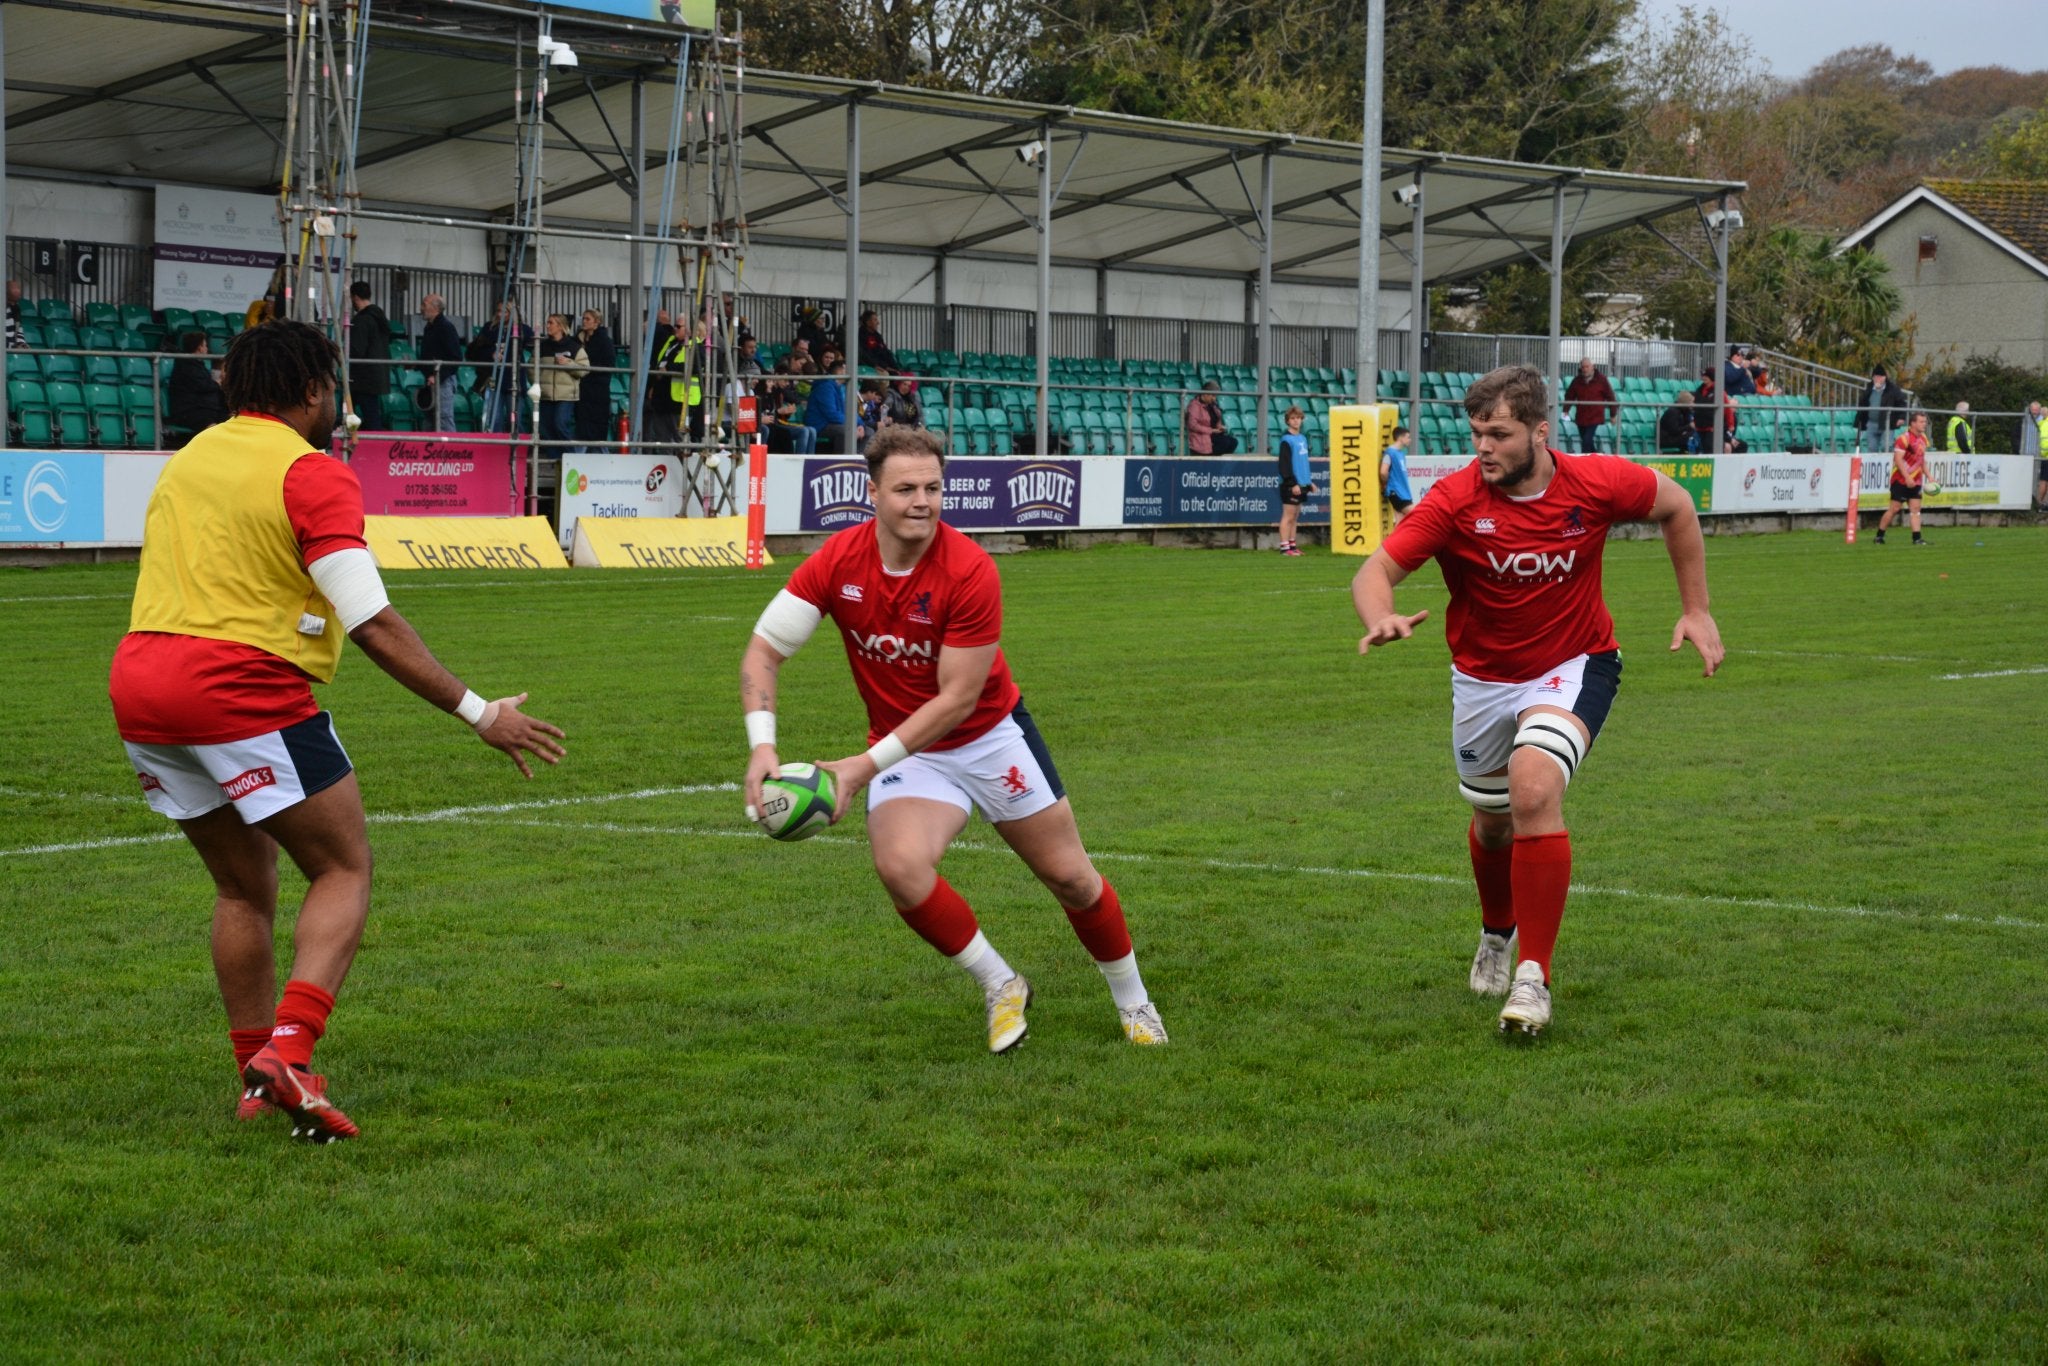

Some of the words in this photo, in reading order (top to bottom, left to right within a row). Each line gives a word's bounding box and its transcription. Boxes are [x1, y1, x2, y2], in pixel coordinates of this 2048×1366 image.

[77, 254, 92, 282] C
[389, 441, 418, 460] Chris
[422, 442, 474, 462] Sedgeman
[388, 462, 461, 476] SCAFFOLDING
[462, 463, 475, 472] LTD
[1691, 463, 1712, 478] SON
[1760, 465, 1806, 480] Microcomms
[1859, 462, 1882, 489] RURO
[1934, 461, 1971, 488] COLLEGE
[405, 484, 429, 495] 01736
[809, 470, 872, 510] TRIBUT
[949, 478, 975, 491] BEER
[977, 478, 991, 491] OF
[1007, 470, 1076, 509] TRIBUTE
[1182, 472, 1210, 487] Official
[1211, 475, 1243, 491] eyecare
[1244, 474, 1279, 491] partners
[1342, 420, 1365, 547] THATCHERS
[1772, 486, 1794, 501] Stand
[394, 497, 468, 509] www.sedgeman.co.uk
[592, 503, 638, 518] Tackling
[942, 496, 960, 510] EST
[962, 496, 995, 510] RUGBY
[1125, 505, 1162, 516] OPTICIANS
[1181, 498, 1190, 512] to
[1191, 496, 1205, 512] the
[1206, 497, 1238, 512] Cornish
[1239, 497, 1268, 512] Pirates
[820, 512, 847, 526] CORNISH
[848, 511, 861, 522] PALE
[1016, 510, 1040, 524] CORNISH
[1040, 510, 1053, 520] PALE
[1053, 511, 1064, 523] ALE
[398, 539, 542, 568] THATCHERS
[620, 541, 748, 568] THATCHERS
[1486, 549, 1576, 576] VOW
[850, 629, 931, 660] VOW
[223, 769, 270, 798] NNOCK'S
